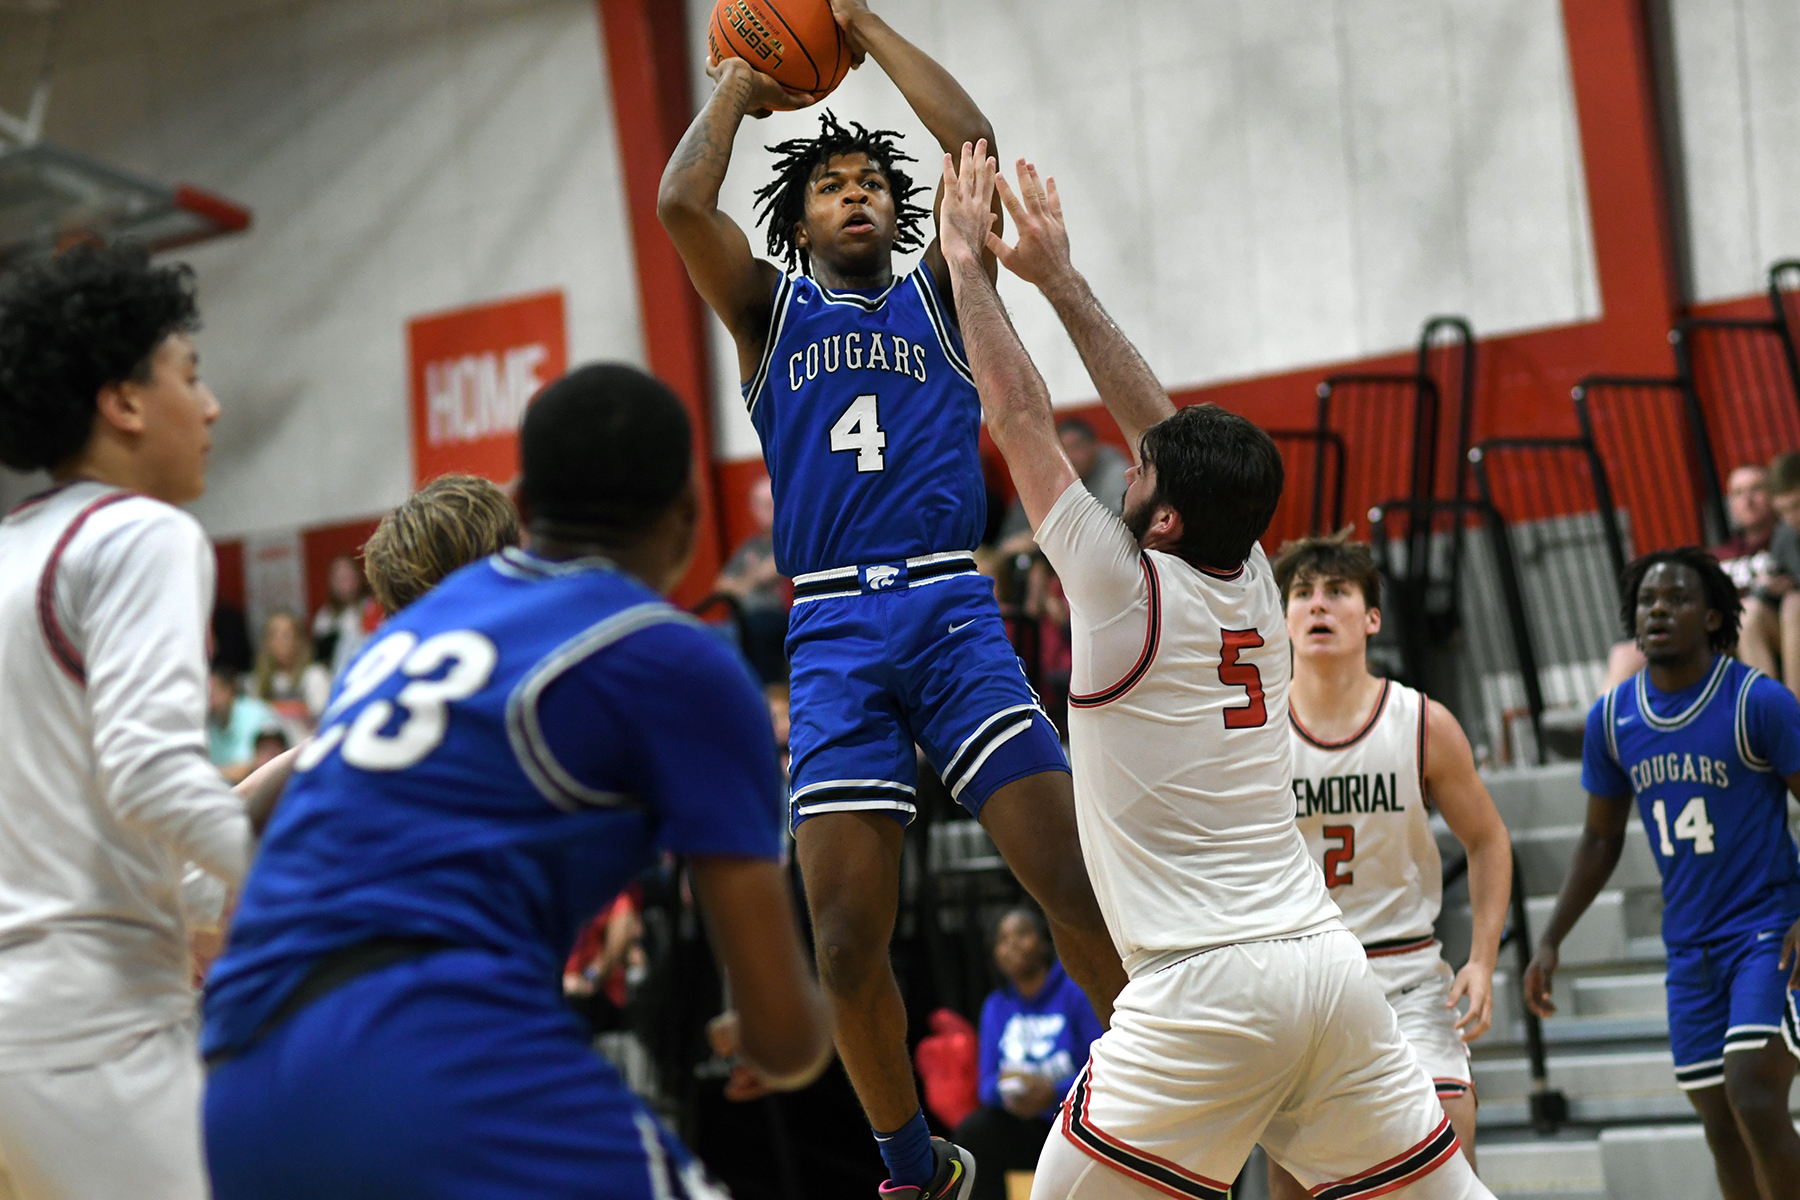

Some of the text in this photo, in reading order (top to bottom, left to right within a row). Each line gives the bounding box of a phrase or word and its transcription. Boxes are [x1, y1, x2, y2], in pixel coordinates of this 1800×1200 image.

[723, 4, 783, 70] LEGACY
[737, 0, 770, 38] 1000
[788, 331, 927, 392] COUGARS
[829, 393, 887, 473] 4
[294, 628, 499, 771] 23
[1217, 628, 1268, 730] 5
[1292, 772, 1405, 818] EMORIAL
[1629, 752, 1730, 795] COUGARS
[1322, 824, 1355, 889] 2
[1651, 796, 1716, 857] 14
